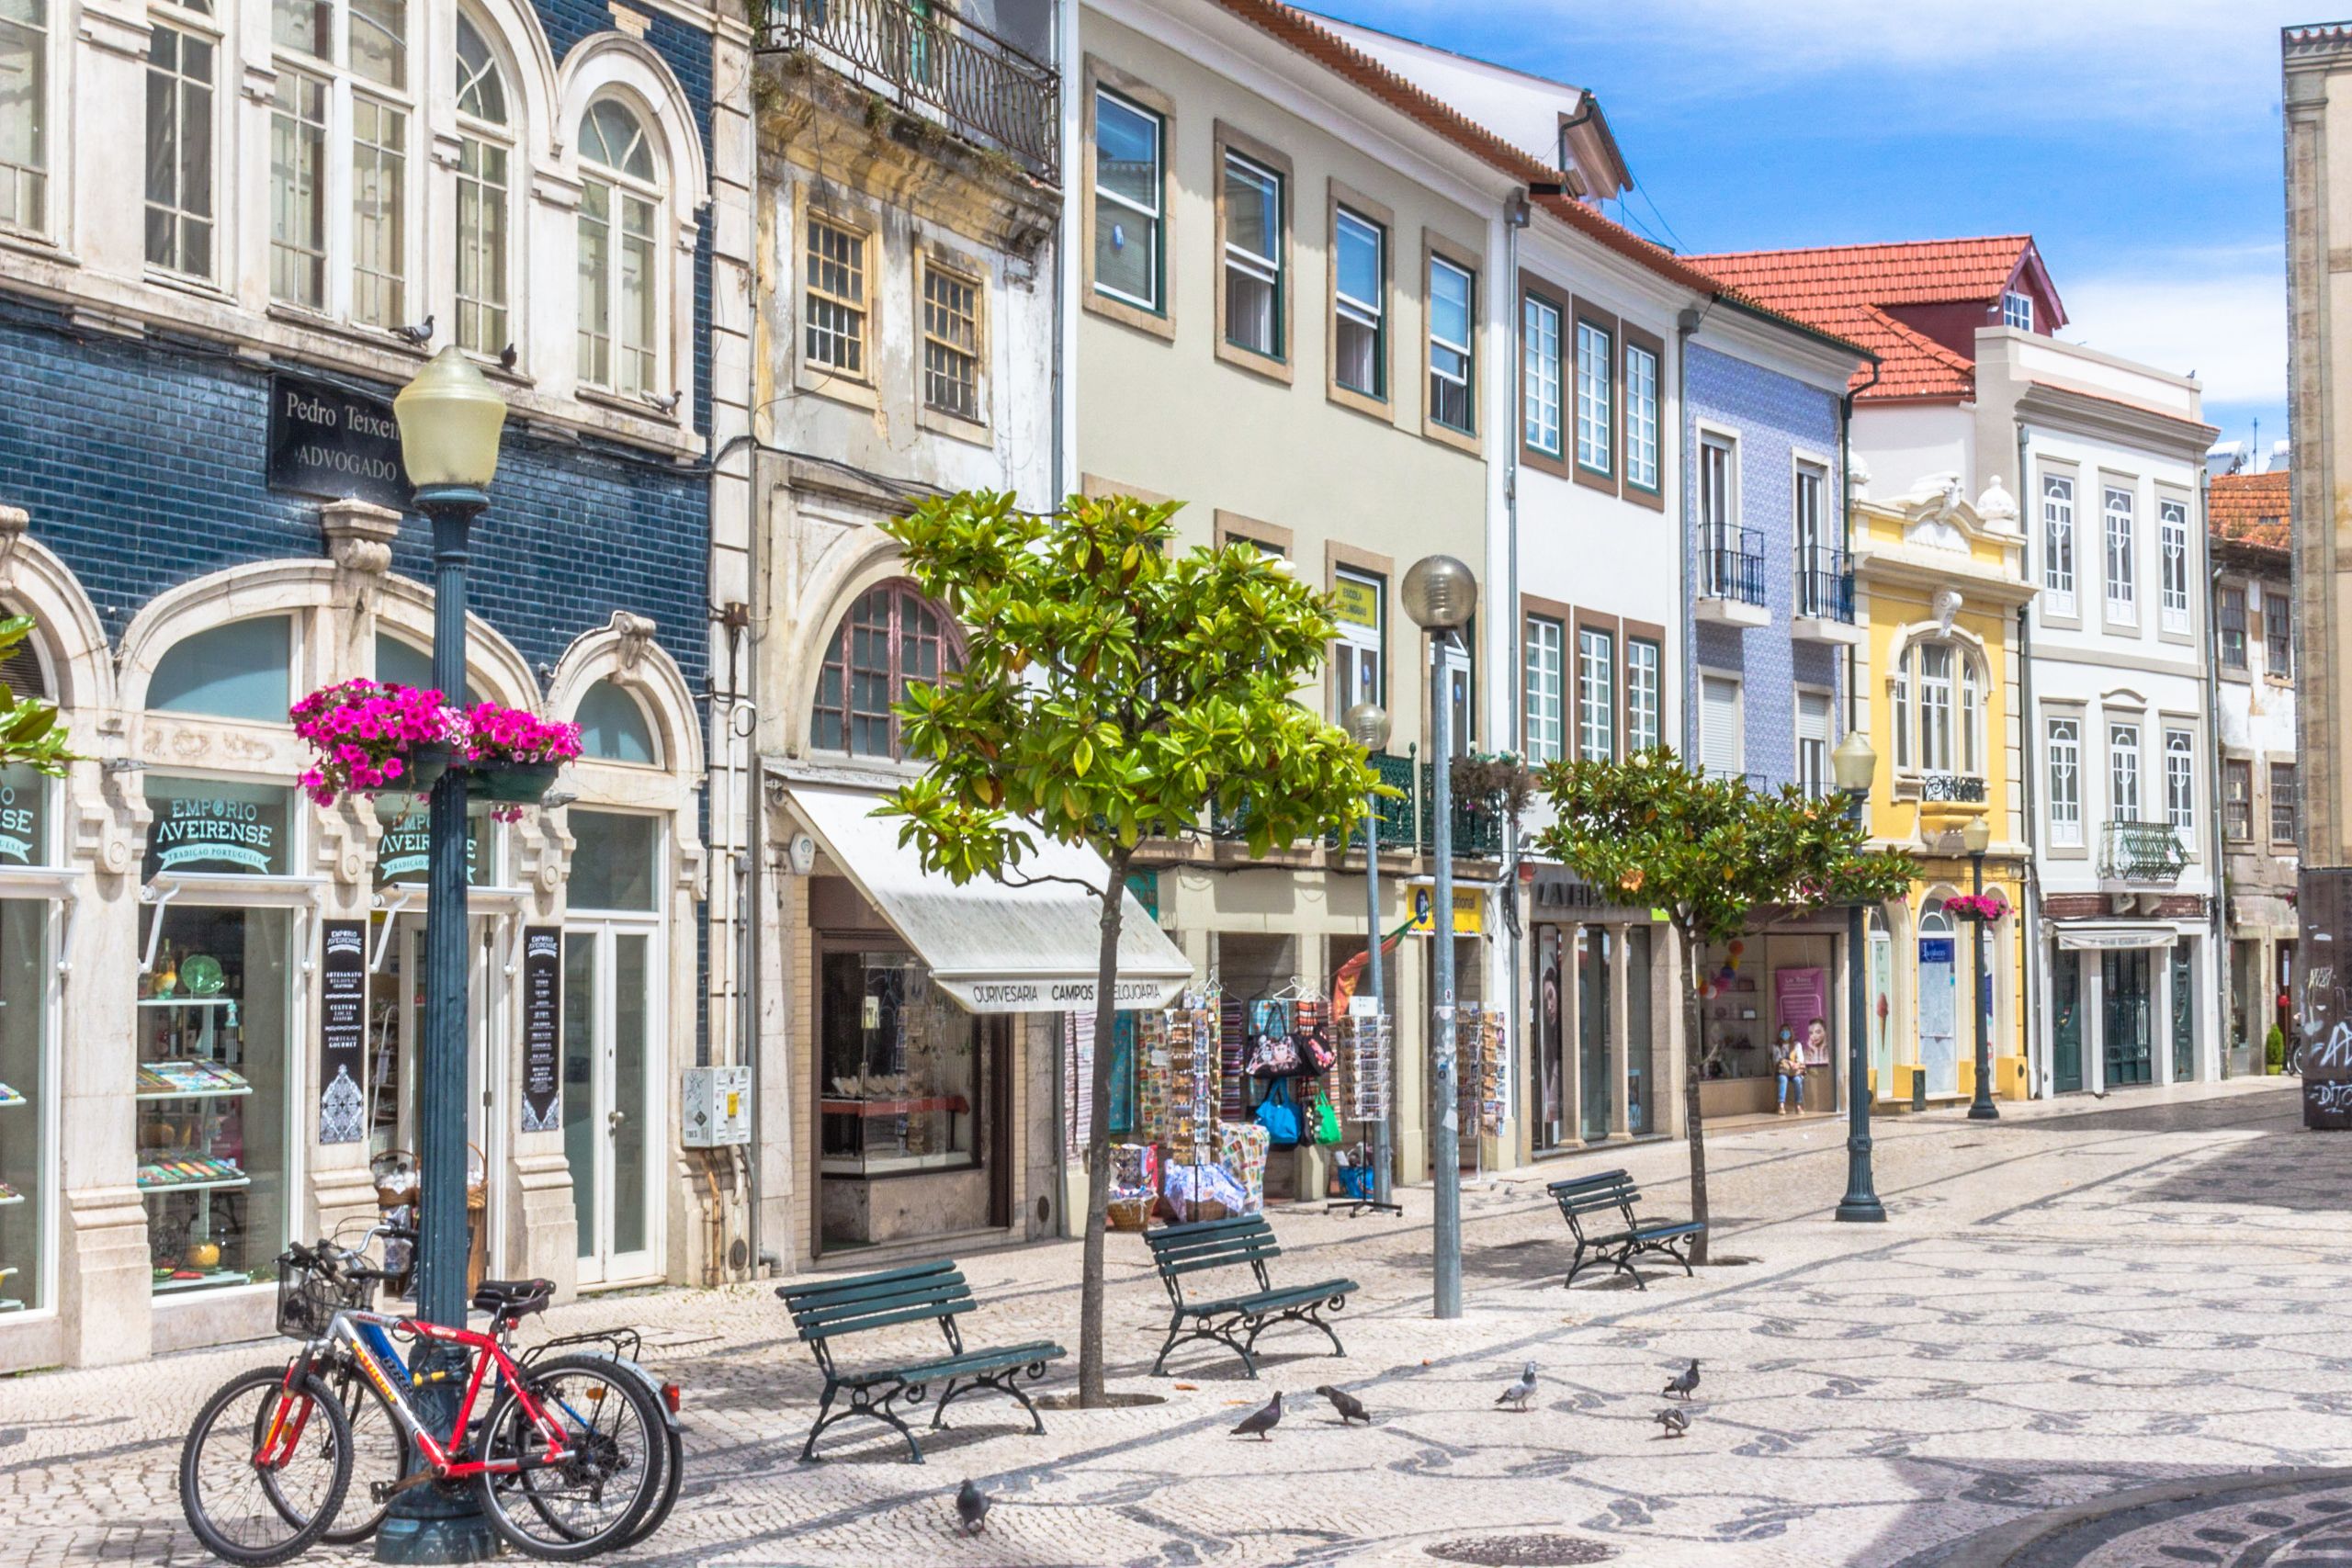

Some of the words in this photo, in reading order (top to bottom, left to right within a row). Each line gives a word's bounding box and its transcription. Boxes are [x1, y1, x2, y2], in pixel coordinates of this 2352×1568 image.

[286, 392, 336, 426] Pedro
[298, 445, 397, 481] ADVOGADO
[156, 820, 272, 847] AVEIRENSE
[974, 986, 1038, 1003] OURIVESARIA
[1051, 985, 1094, 1001] CAMPOS
[1114, 984, 1161, 1000] ELOJOARIA
